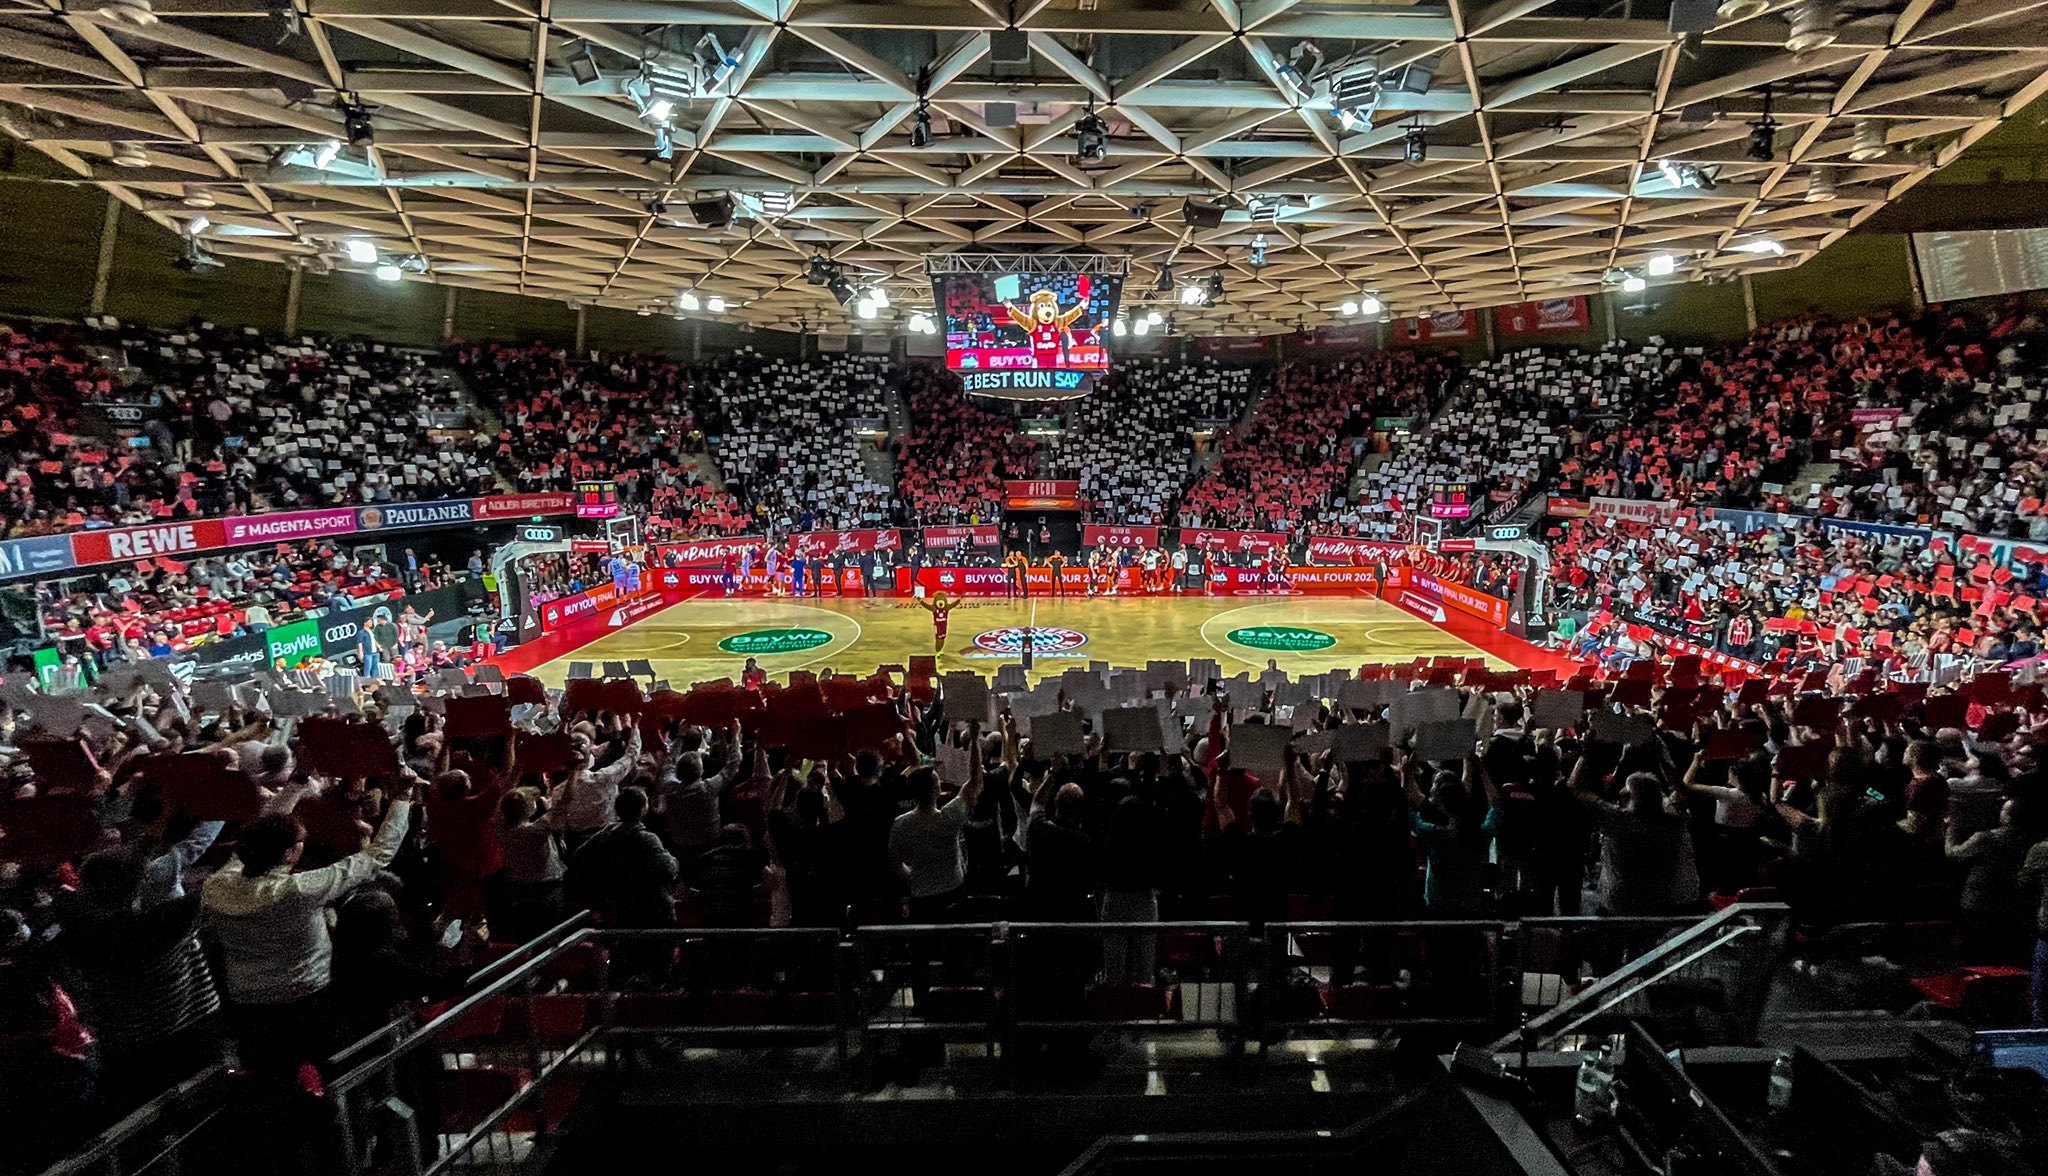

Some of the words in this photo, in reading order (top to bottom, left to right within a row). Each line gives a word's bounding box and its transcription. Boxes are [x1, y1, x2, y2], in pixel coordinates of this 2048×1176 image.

[990, 356, 1014, 367] BUY
[974, 372, 1010, 389] BEST
[1013, 371, 1051, 388] RUN
[1055, 371, 1079, 388] SAP
[249, 518, 313, 536] MAGENTA
[313, 514, 351, 530] SPORT
[385, 503, 471, 525] PAULANER
[107, 525, 197, 558] REWE
[689, 574, 711, 584] BUY
[965, 574, 987, 584] BUY
[1238, 573, 1260, 583] BUY
[1292, 573, 1322, 582] FINAL
[1323, 573, 1352, 582] FOUR
[564, 603, 578, 616] BUY
[578, 597, 597, 613] YOUR
[597, 590, 615, 603] FINAL
[1420, 578, 1431, 591] BUY
[1431, 582, 1444, 596] YOUR
[1444, 586, 1458, 600] FINAL
[1459, 593, 1474, 606] FOUR
[1474, 598, 1488, 613] 2022
[270, 637, 318, 659] BayWa
